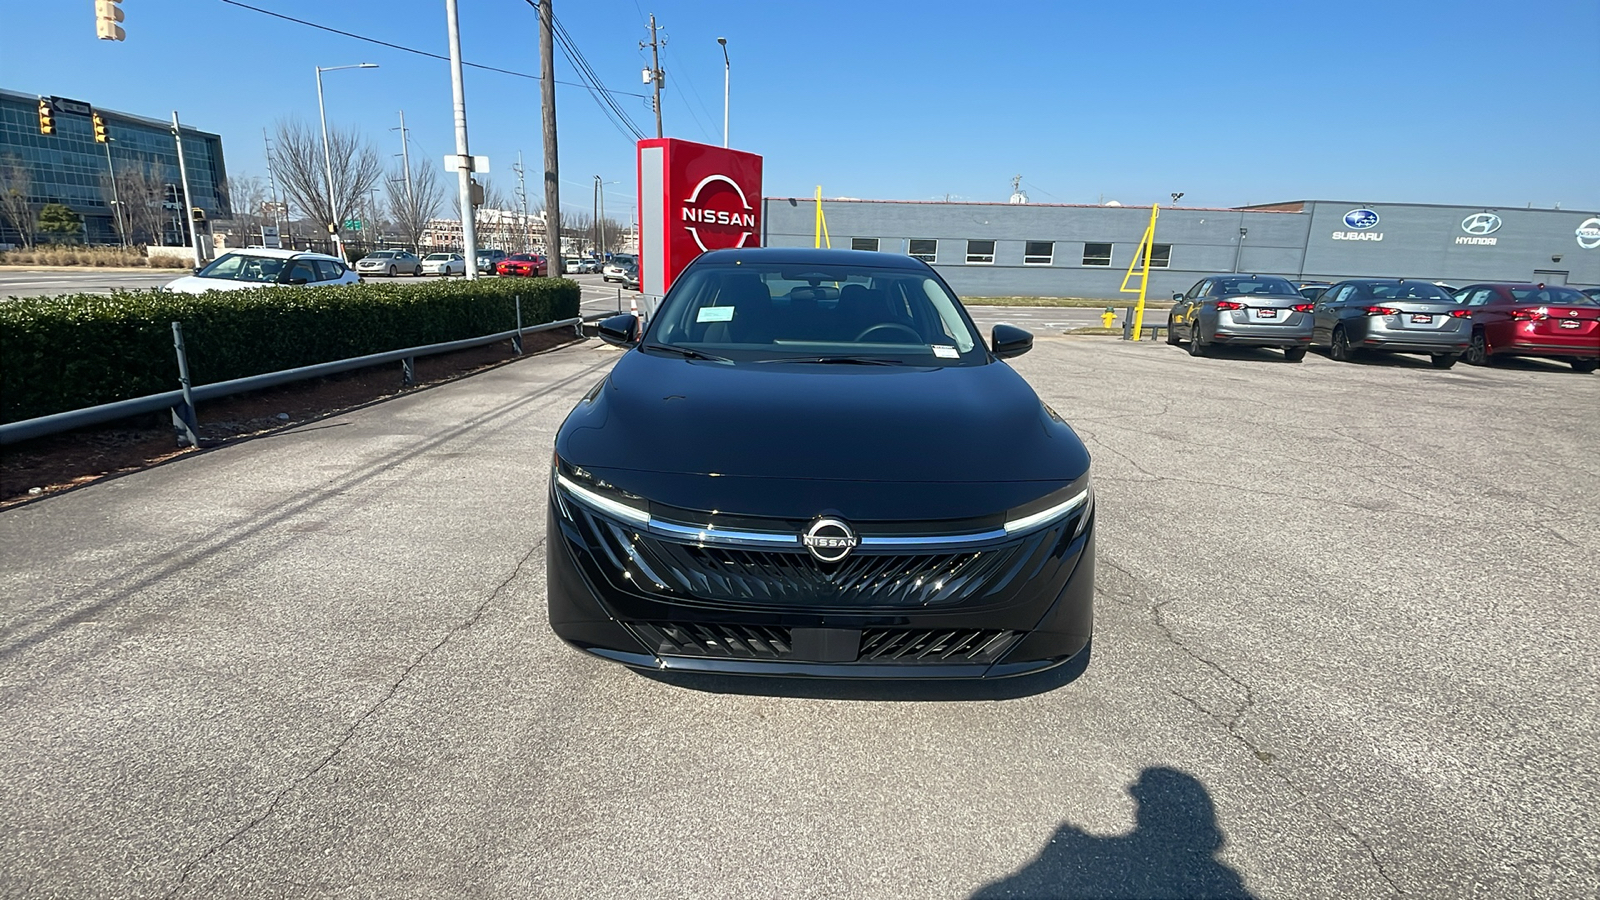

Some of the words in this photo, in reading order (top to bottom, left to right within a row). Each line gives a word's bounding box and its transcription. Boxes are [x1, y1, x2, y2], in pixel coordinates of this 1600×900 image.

[682, 207, 755, 227] NISSAN
[1332, 232, 1383, 242] SUBARU
[1455, 236, 1497, 245] HYUNDAI
[804, 538, 857, 547] NISSAN
